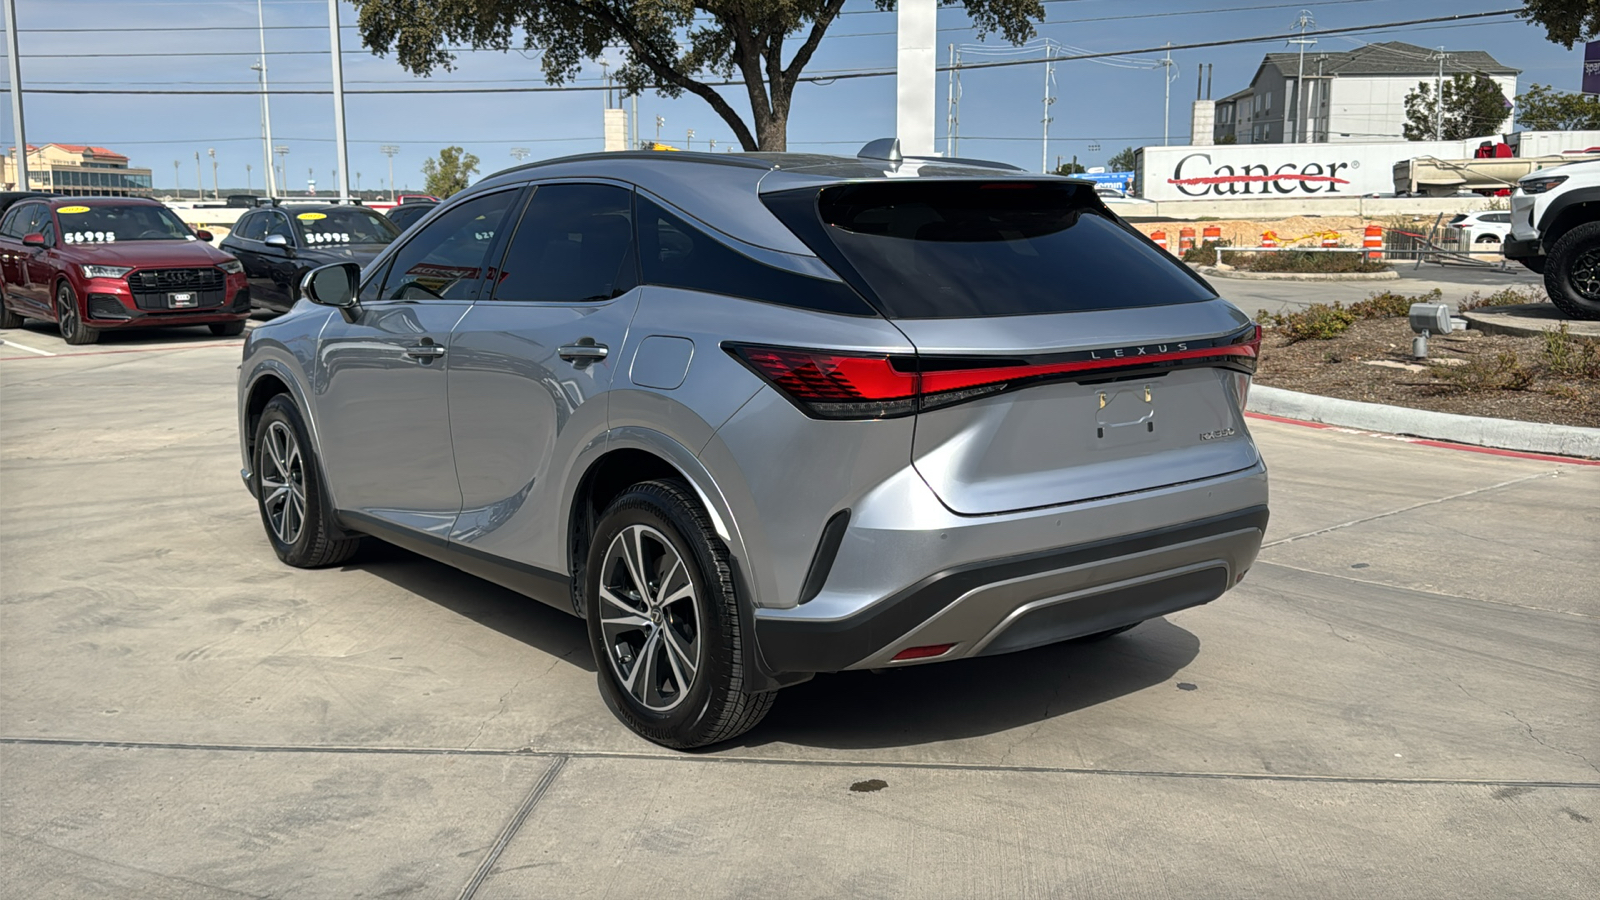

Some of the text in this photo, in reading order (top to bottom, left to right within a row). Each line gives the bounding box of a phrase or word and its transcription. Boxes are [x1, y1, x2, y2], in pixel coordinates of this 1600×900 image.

[1174, 153, 1348, 196] Cancer
[64, 231, 116, 244] 56995
[1090, 343, 1188, 359] LEXUS
